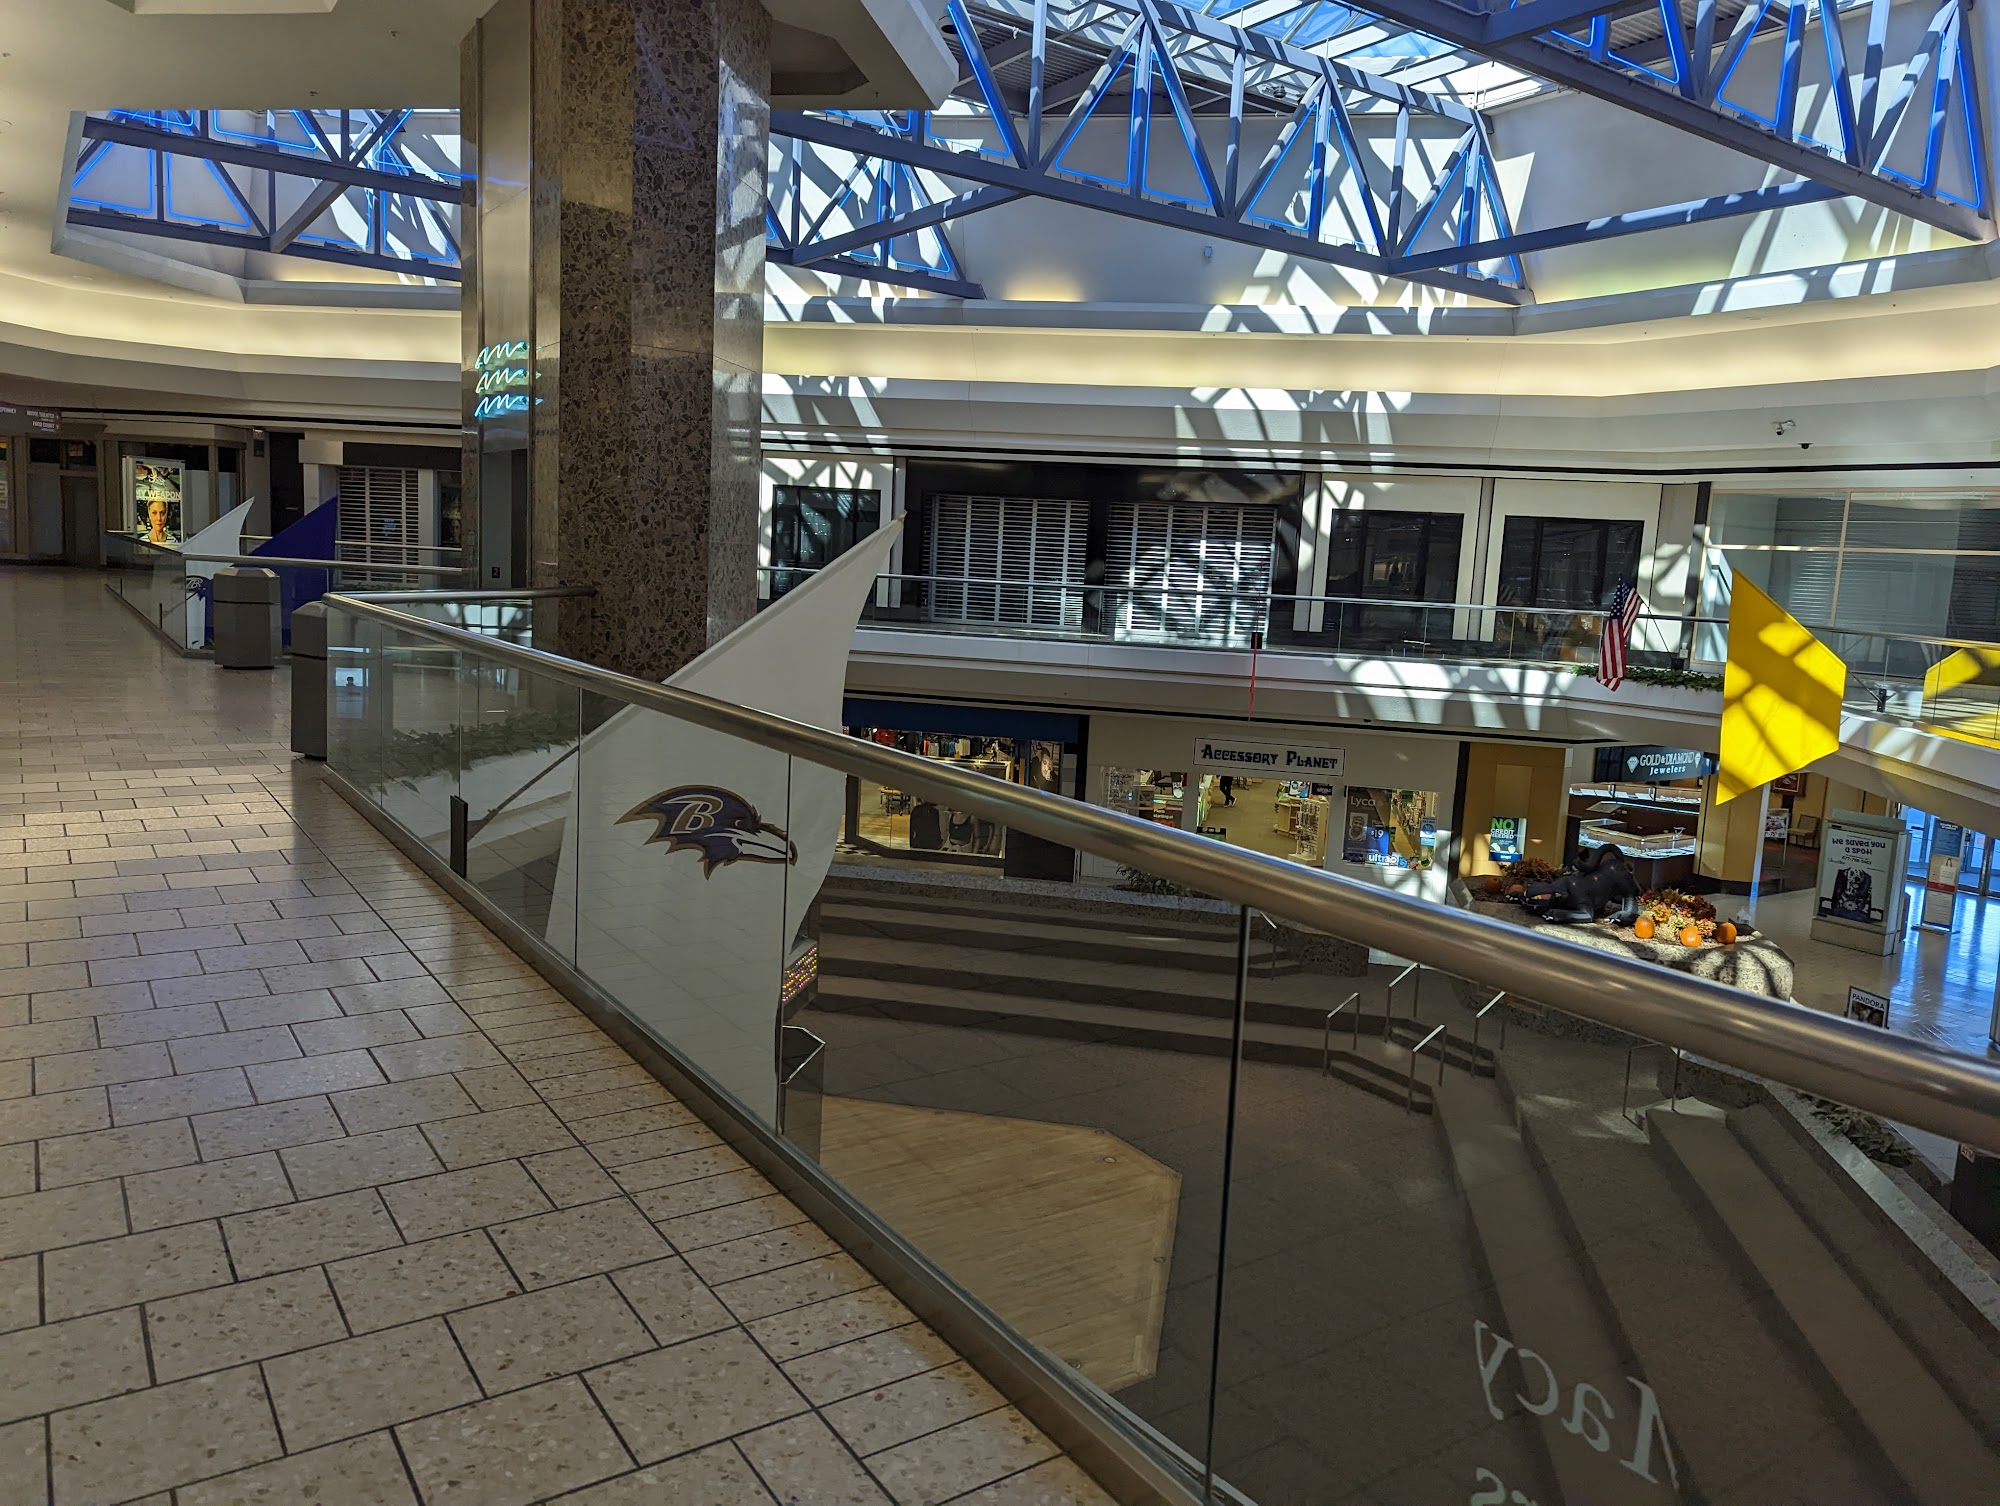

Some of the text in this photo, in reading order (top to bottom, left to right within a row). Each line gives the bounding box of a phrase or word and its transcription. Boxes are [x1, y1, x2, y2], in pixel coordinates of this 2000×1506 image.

[148, 489, 181, 499] WEAPON
[1201, 744, 1338, 769] ACCESSORY PLANET
[1640, 754, 1660, 766] GOLD
[1665, 752, 1694, 765] DIAMOND
[1649, 766, 1686, 775] Jewelers
[1350, 796, 1376, 807] Lyca
[663, 794, 723, 834] B
[1491, 818, 1515, 830] NO
[1371, 829, 1384, 838] $19
[1852, 993, 1885, 1010] PANDORA
